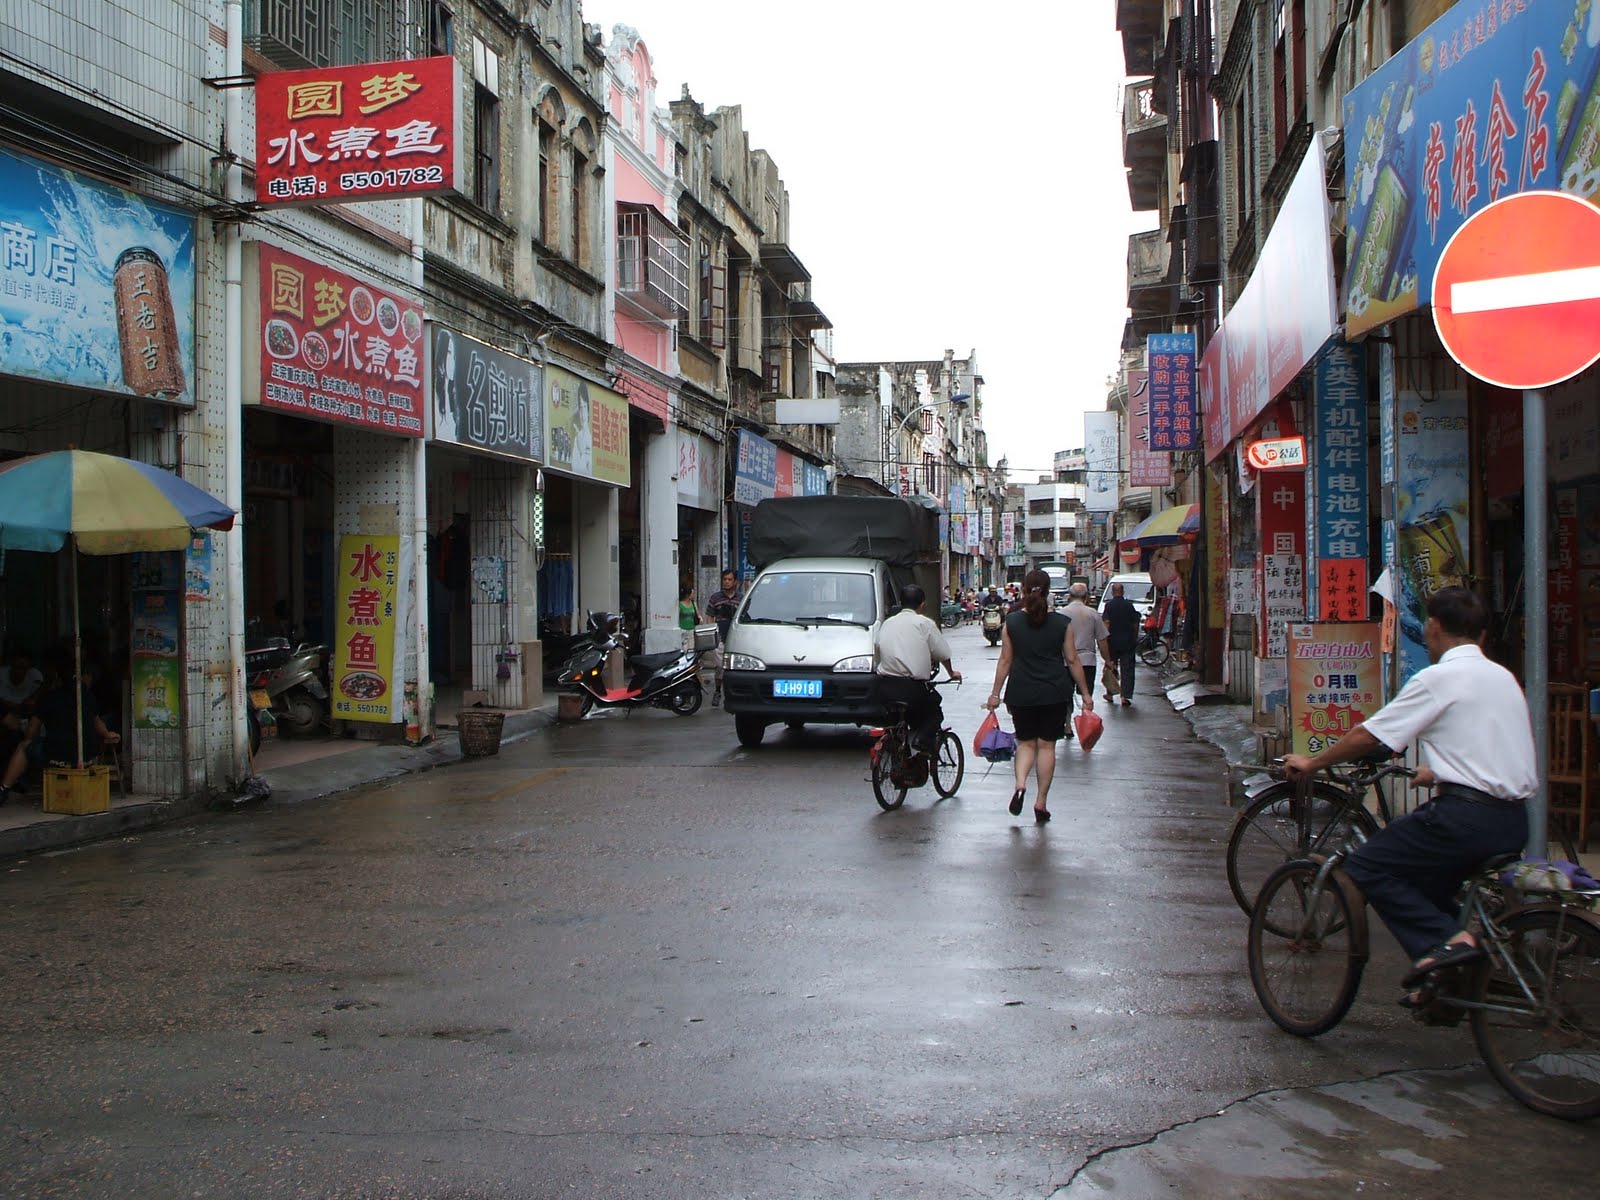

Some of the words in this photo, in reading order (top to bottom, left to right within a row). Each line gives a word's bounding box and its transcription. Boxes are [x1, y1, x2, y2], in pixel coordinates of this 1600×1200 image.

[287, 71, 421, 119] 圆梦
[267, 120, 443, 167] 水煮鱼
[340, 166, 443, 191] 5501782
[1, 221, 77, 286] 商店
[129, 272, 159, 372] 王老吉
[270, 263, 347, 329] 圆梦
[332, 325, 421, 388] 水煮鱼
[466, 350, 528, 446] 名剪坊
[591, 399, 629, 458] 昌隆商行
[1153, 355, 1171, 446] 收购二手手机
[1173, 354, 1191, 446] 专业手机维修
[1279, 447, 1300, 459] 公话
[1273, 486, 1295, 556] 中国
[346, 544, 384, 671] 水煮鱼
[384, 552, 395, 617] 35元/条
[1296, 642, 1374, 659] 五邑自由人
[357, 704, 388, 715] 5501782
[1306, 693, 1374, 704] 全省接听免费
[1314, 675, 1358, 689] 0月租
[1311, 710, 1350, 731] 0.1
